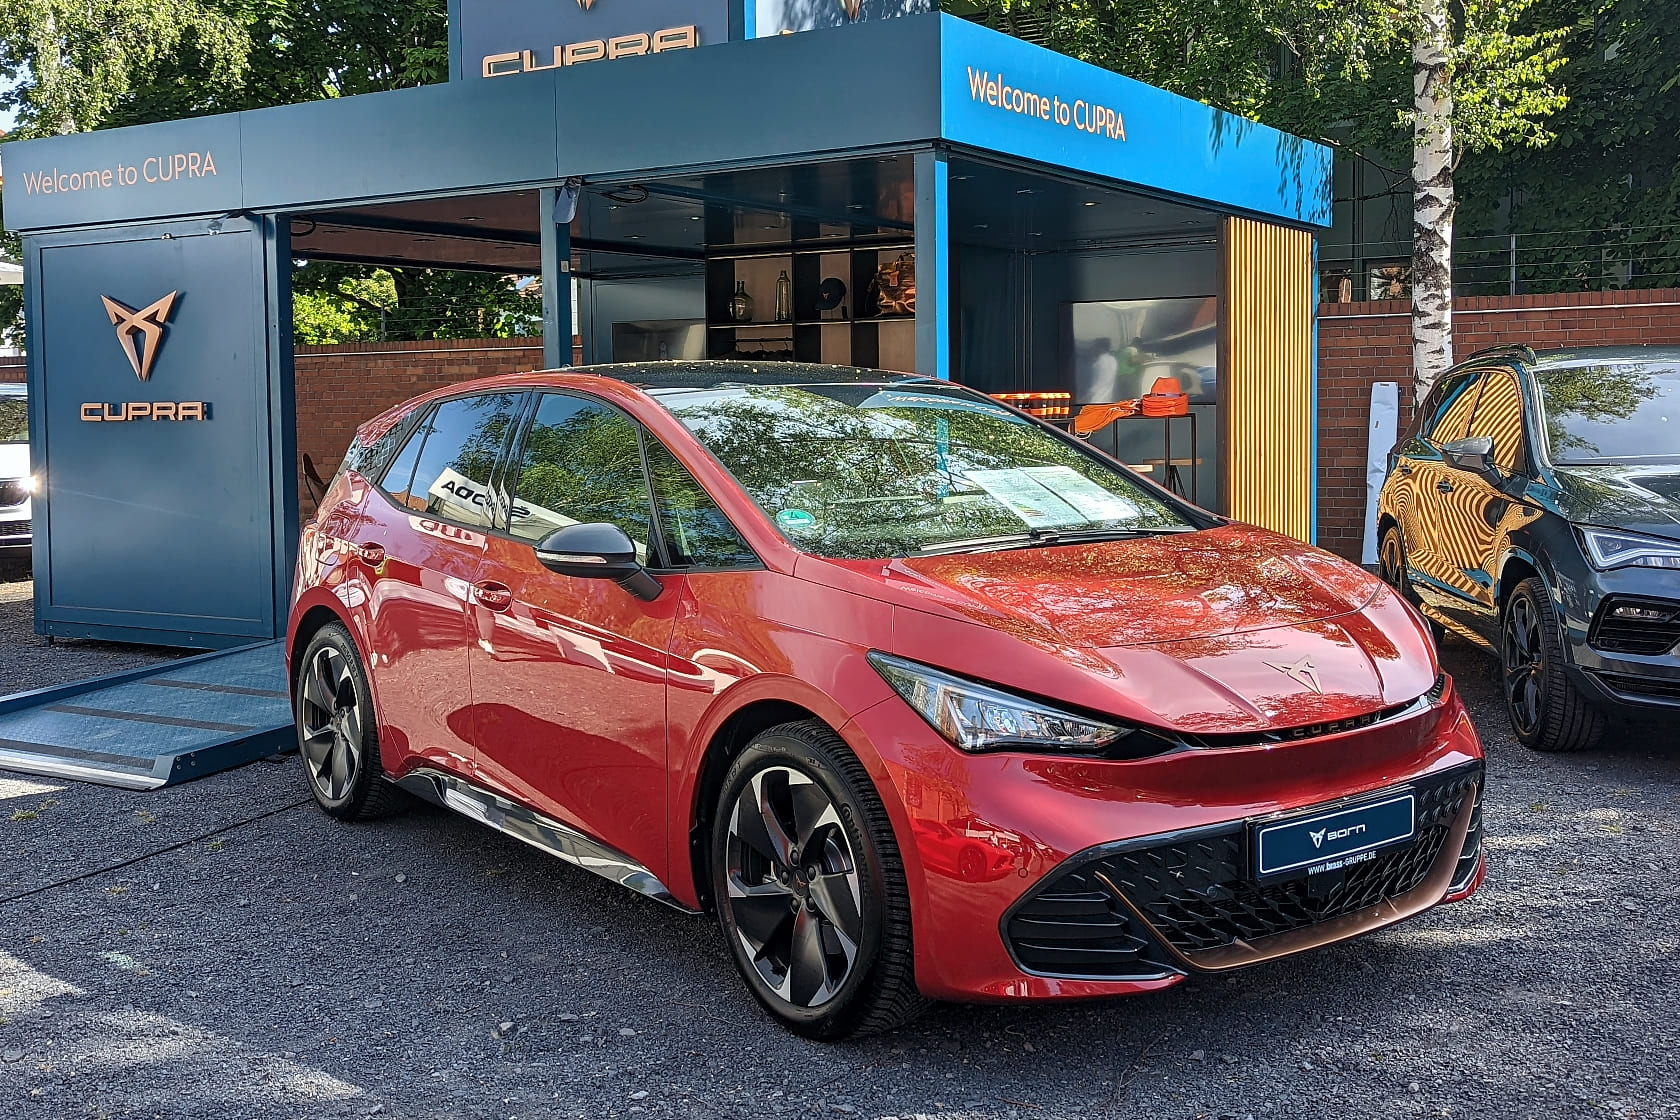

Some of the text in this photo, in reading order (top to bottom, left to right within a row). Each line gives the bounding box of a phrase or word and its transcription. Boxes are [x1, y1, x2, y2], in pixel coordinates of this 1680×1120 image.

[482, 25, 697, 78] CUPRA
[968, 66, 1127, 143] Welcome to CUPRA
[23, 150, 218, 196] Welcome to CUPRA
[80, 401, 205, 422] CUPRA
